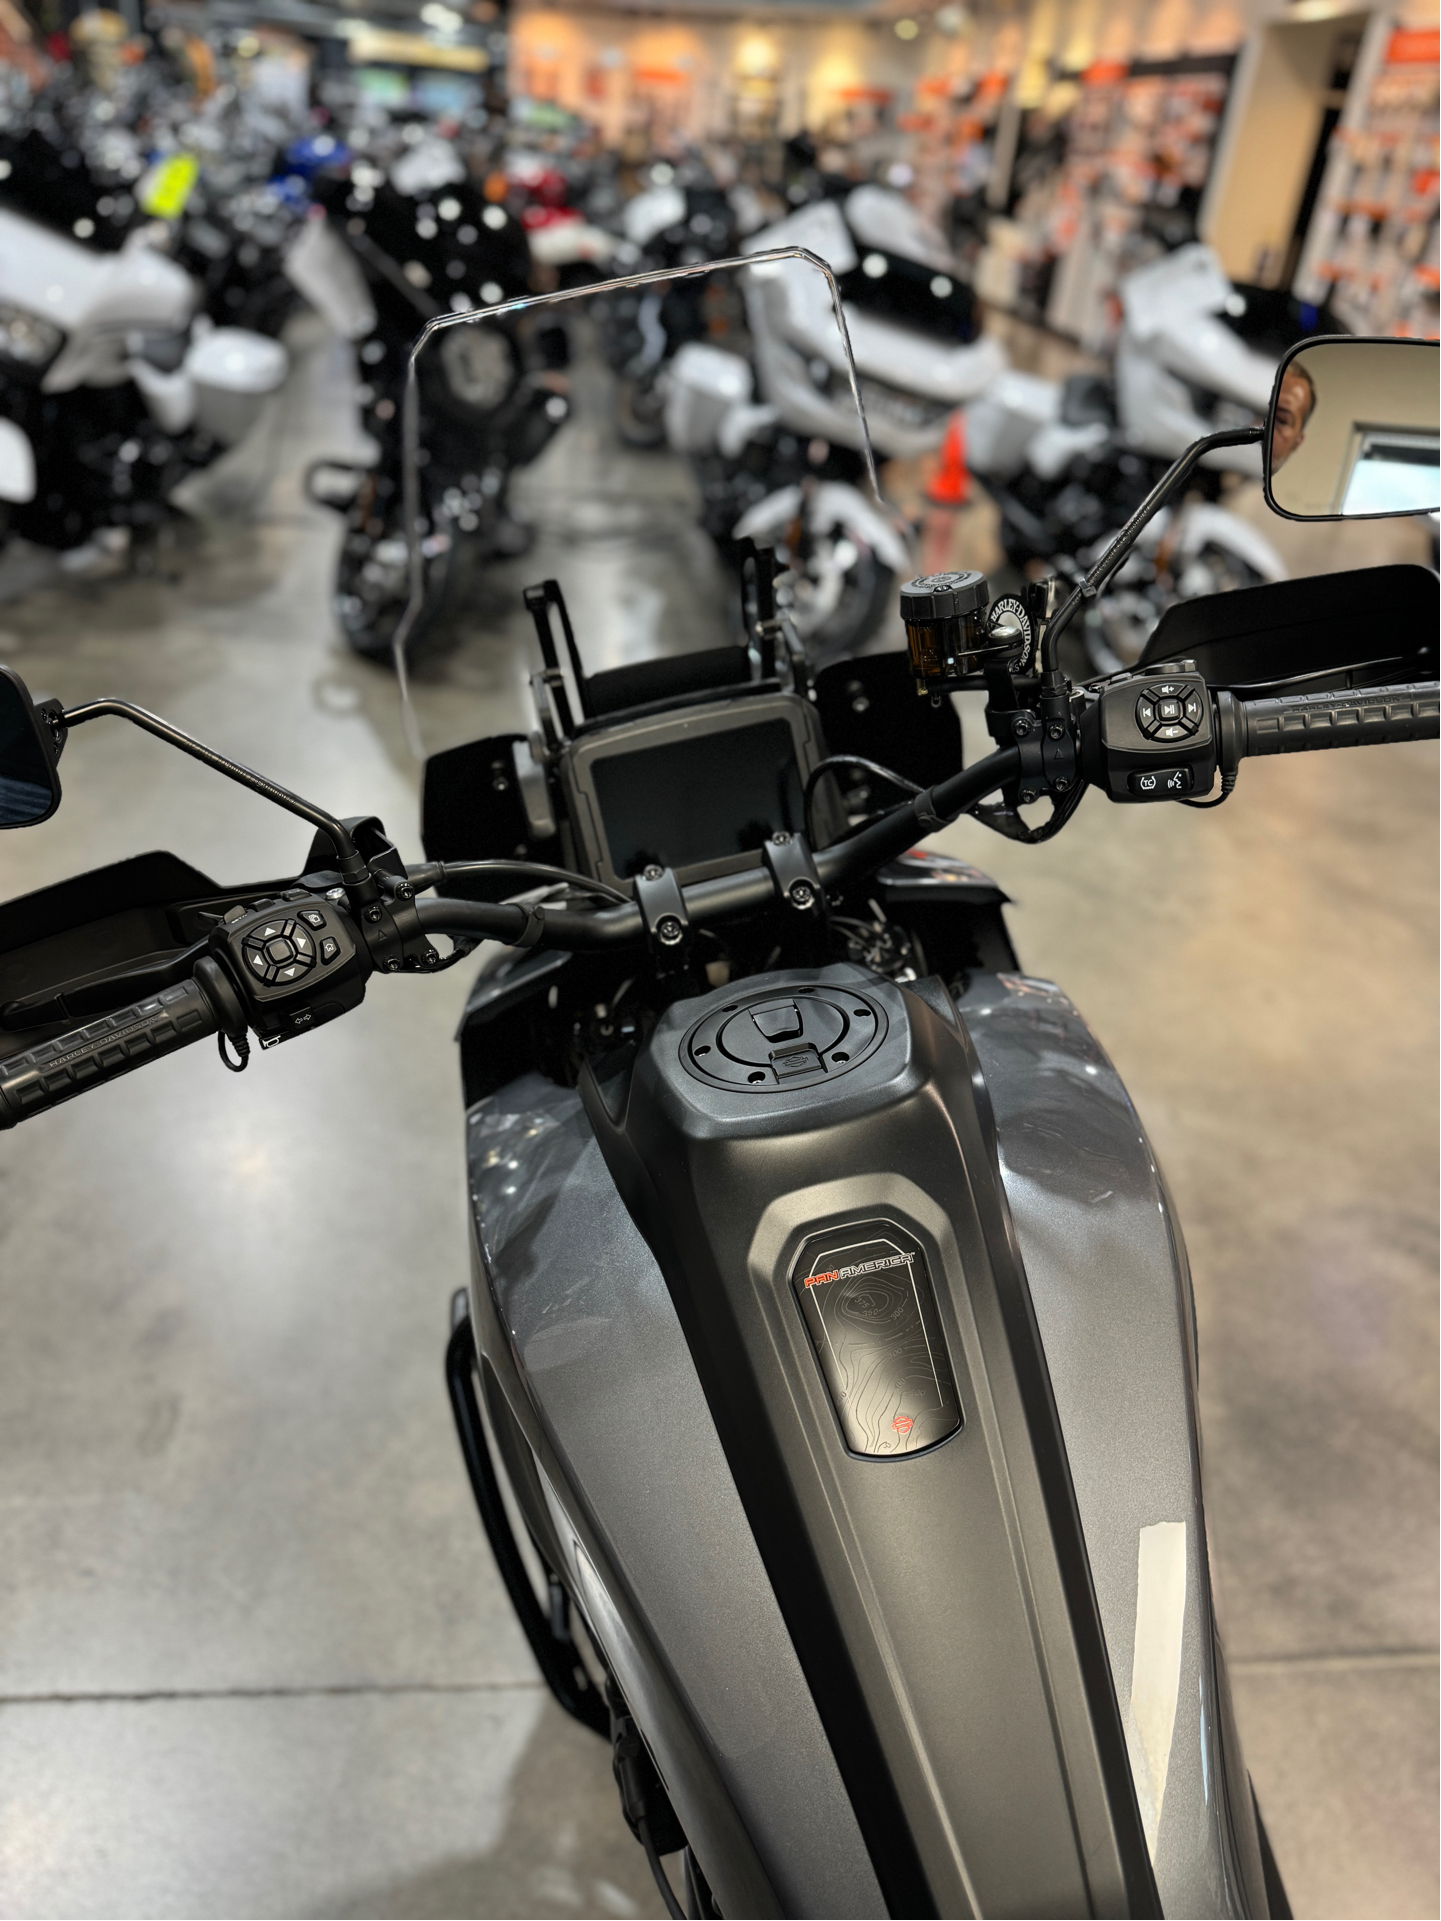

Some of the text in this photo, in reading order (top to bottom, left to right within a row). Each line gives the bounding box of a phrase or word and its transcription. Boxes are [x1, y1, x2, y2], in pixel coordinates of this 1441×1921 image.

[1143, 779, 1154, 787] TC
[804, 1270, 839, 1289] PAN
[862, 1308, 879, 1317] 350
[890, 1307, 904, 1321] 300
